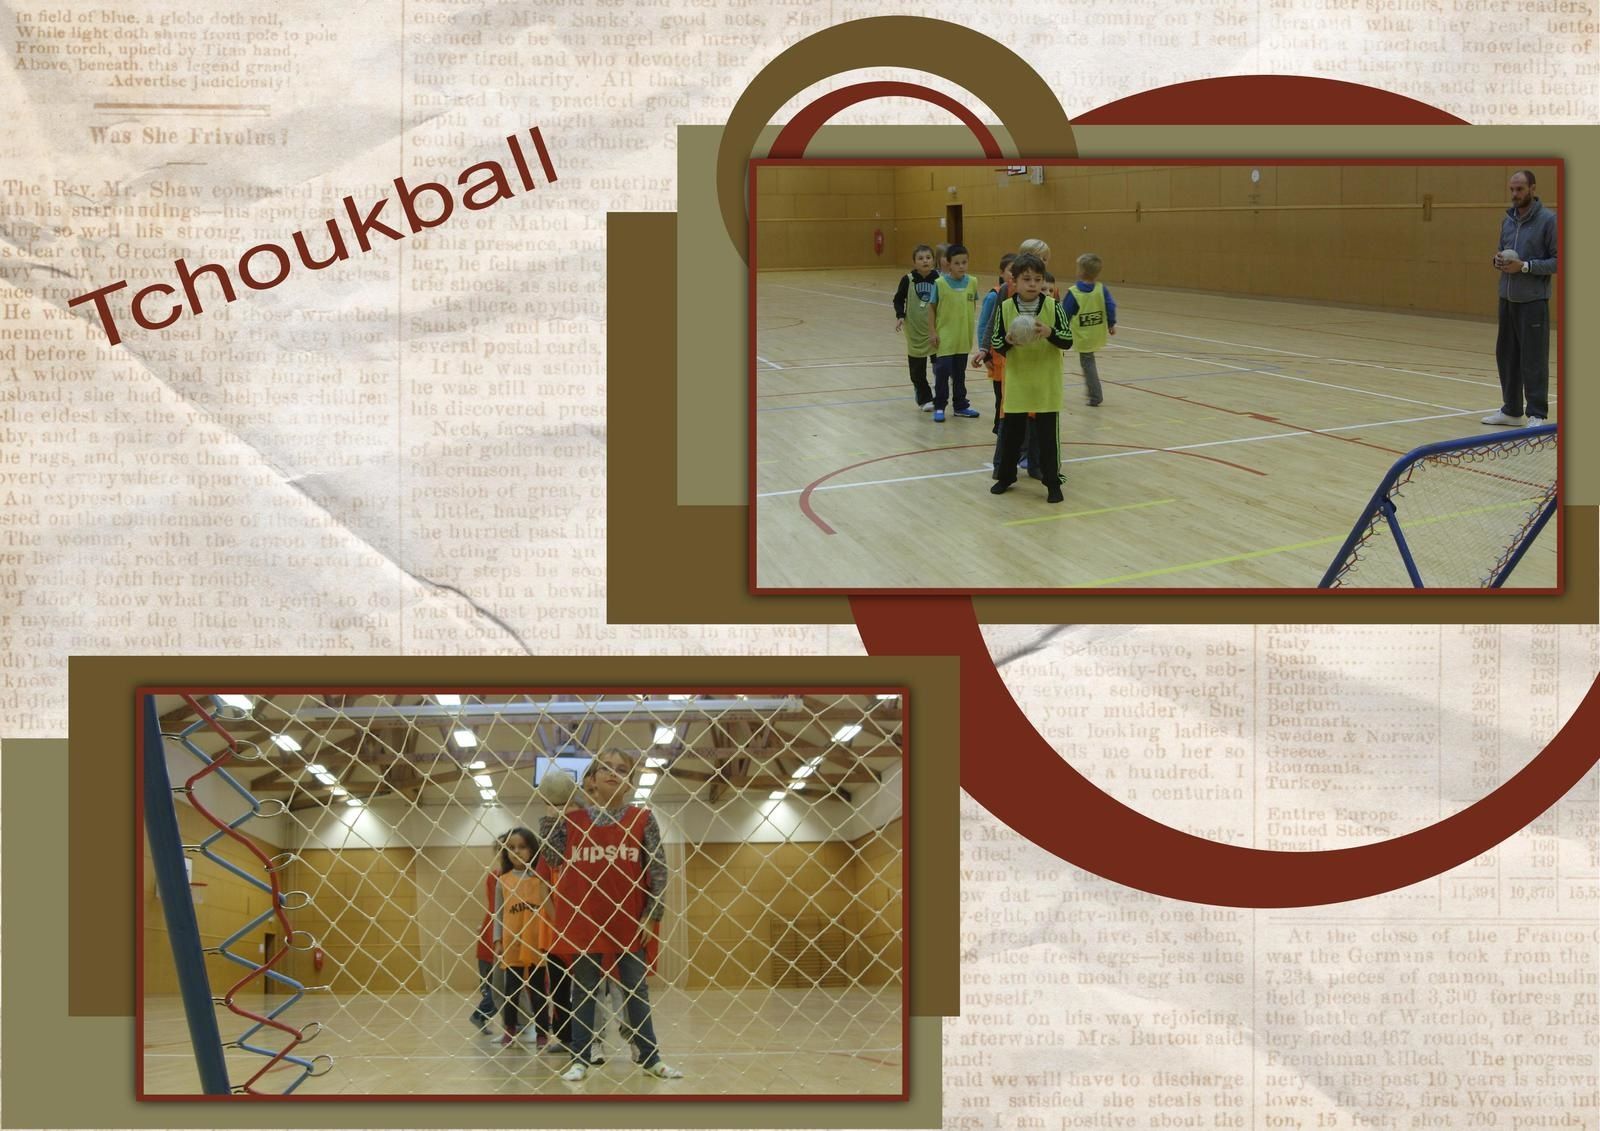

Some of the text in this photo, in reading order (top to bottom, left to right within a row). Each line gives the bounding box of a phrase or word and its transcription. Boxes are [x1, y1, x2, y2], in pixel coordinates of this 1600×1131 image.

[16, 12, 32, 23] In
[78, 11, 95, 22] of
[211, 12, 243, 25] doth
[661, 13, 706, 29] good
[1213, 10, 1248, 26] She
[16, 28, 66, 39] While
[72, 28, 109, 42] light
[115, 28, 149, 39] doth
[247, 29, 281, 43] pole
[286, 30, 299, 41] to
[305, 30, 338, 44] pole
[602, 33, 653, 47] angel
[16, 44, 60, 55] From
[66, 44, 112, 57] torch,
[178, 44, 196, 58] by
[1570, 40, 1592, 54] of
[414, 52, 702, 66] never and who devoted
[16, 60, 71, 73] Above,
[149, 60, 177, 71] this
[188, 60, 240, 74] legend
[91, 127, 131, 144] Was
[142, 127, 177, 143] She
[3, 180, 202, 198] The Rev. Mr. Shaw
[591, 177, 672, 194] entering
[510, 216, 575, 231] Mabel
[177, 223, 245, 242] strong,
[115, 243, 192, 259] Grecian
[441, 237, 466, 250] his
[412, 257, 448, 271] her,
[4, 304, 30, 320] He
[160, 327, 201, 341] used
[25, 346, 86, 362] before
[410, 340, 539, 358] several postal
[34, 367, 389, 384] widow who her
[83, 388, 114, 402] she
[488, 382, 585, 395] still more
[41, 409, 96, 424] eldest
[145, 409, 175, 424] the
[445, 402, 545, 416] discovered
[115, 430, 186, 447] pair of
[29, 450, 239, 467] rags, and, worse than
[479, 444, 544, 460] golden
[446, 464, 527, 479] crimson,
[434, 505, 484, 520] little,
[6, 532, 190, 550] The woman, with
[135, 552, 199, 566] rocked
[435, 544, 559, 564] Acting upon
[152, 572, 184, 586] her
[473, 564, 520, 580] steps
[97, 592, 390, 607] know what do
[537, 605, 599, 622] person
[147, 614, 238, 629] the little
[1206, 643, 1245, 656] seb-
[1206, 664, 1245, 677] seb-
[1043, 706, 1089, 721] your
[1088, 726, 1227, 742] looking ladies
[1266, 730, 1435, 744] Sweden & Norway
[1103, 746, 1245, 759] me ob so
[1152, 788, 1243, 800] centurian
[1268, 807, 1325, 821] Entire
[1268, 823, 1328, 837] United
[1287, 928, 1497, 944] At close the
[1044, 948, 1088, 964] fresh
[1448, 949, 1550, 963] took from
[1137, 970, 1244, 989] egg in case
[1400, 970, 1505, 986] of cannon,
[968, 1013, 1012, 1026] went
[1027, 1014, 1050, 1026] on
[1106, 1015, 1148, 1029] way
[960, 1031, 1243, 1045] afterwards said
[1467, 1052, 1504, 1067] The
[1513, 1054, 1592, 1071] progress
[1152, 1072, 1244, 1090] discharge
[1381, 1073, 1505, 1089] past 10 years
[962, 1092, 1243, 1108] am satisfied she steals the
[1421, 1093, 1458, 1108] first
[1061, 1112, 1204, 1130] positive about
[1265, 1115, 1301, 1130] ton,
[1318, 1113, 1337, 1127] 15
[1412, 1113, 1451, 1128] shot
[1467, 1114, 1496, 1127] 700
[1513, 1113, 1586, 1129] pounds,
